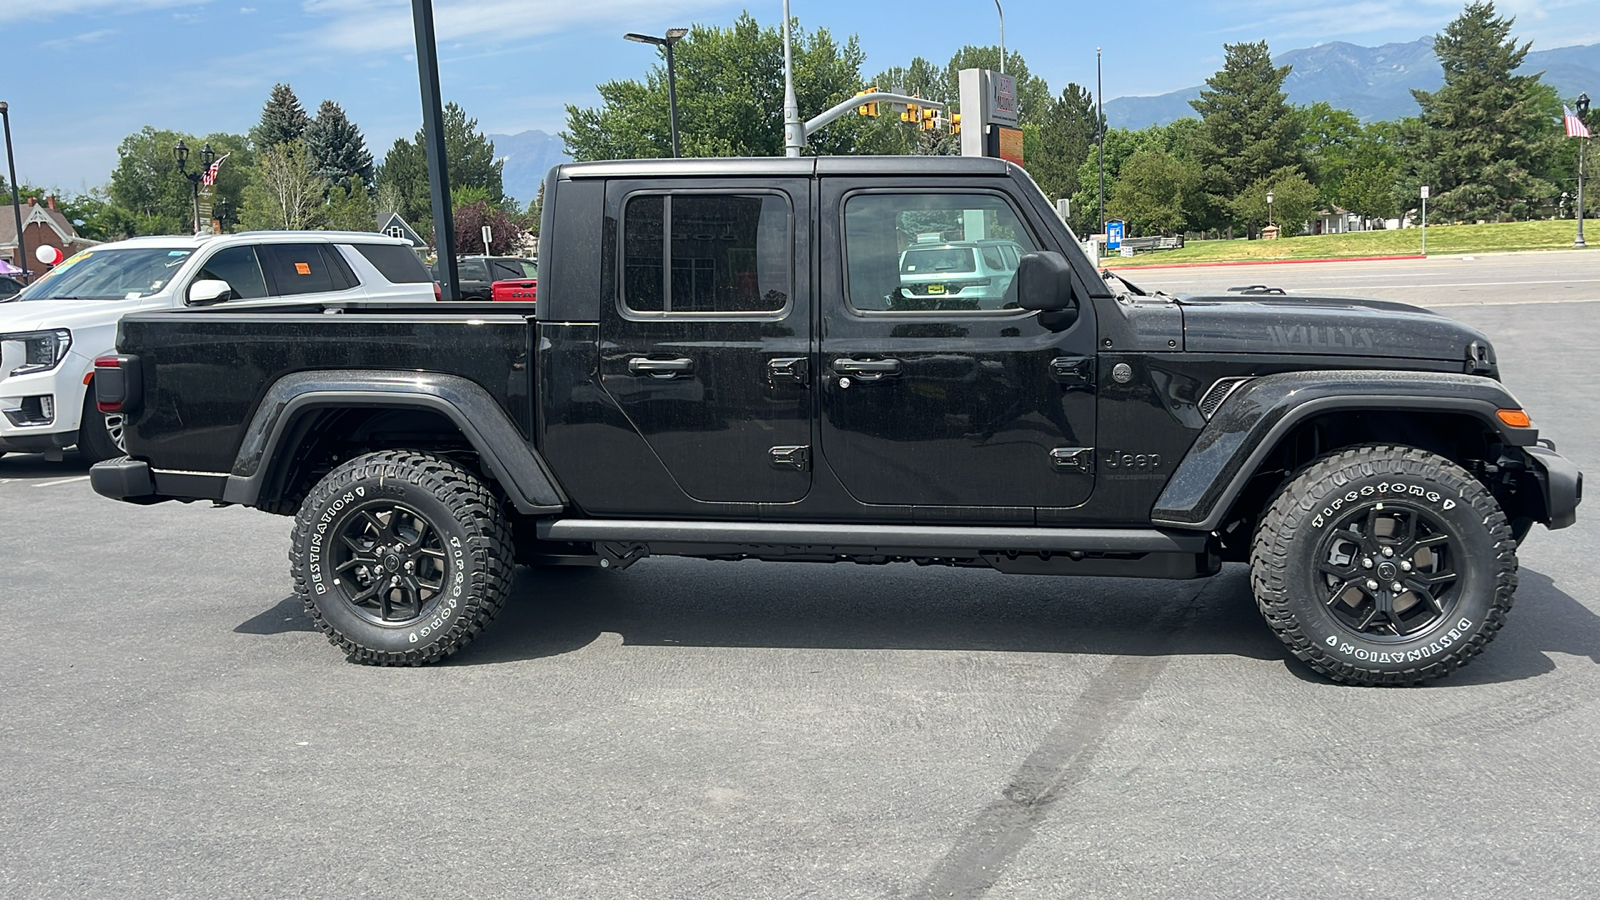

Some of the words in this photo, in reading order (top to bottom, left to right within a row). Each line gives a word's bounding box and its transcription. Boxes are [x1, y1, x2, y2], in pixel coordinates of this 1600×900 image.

[1266, 325, 1374, 348] WILLYS
[1106, 450, 1161, 473] Jeep
[1312, 482, 1441, 528] Firestone
[309, 491, 355, 595] DESTINATION
[1339, 617, 1473, 663] DESTINATION
